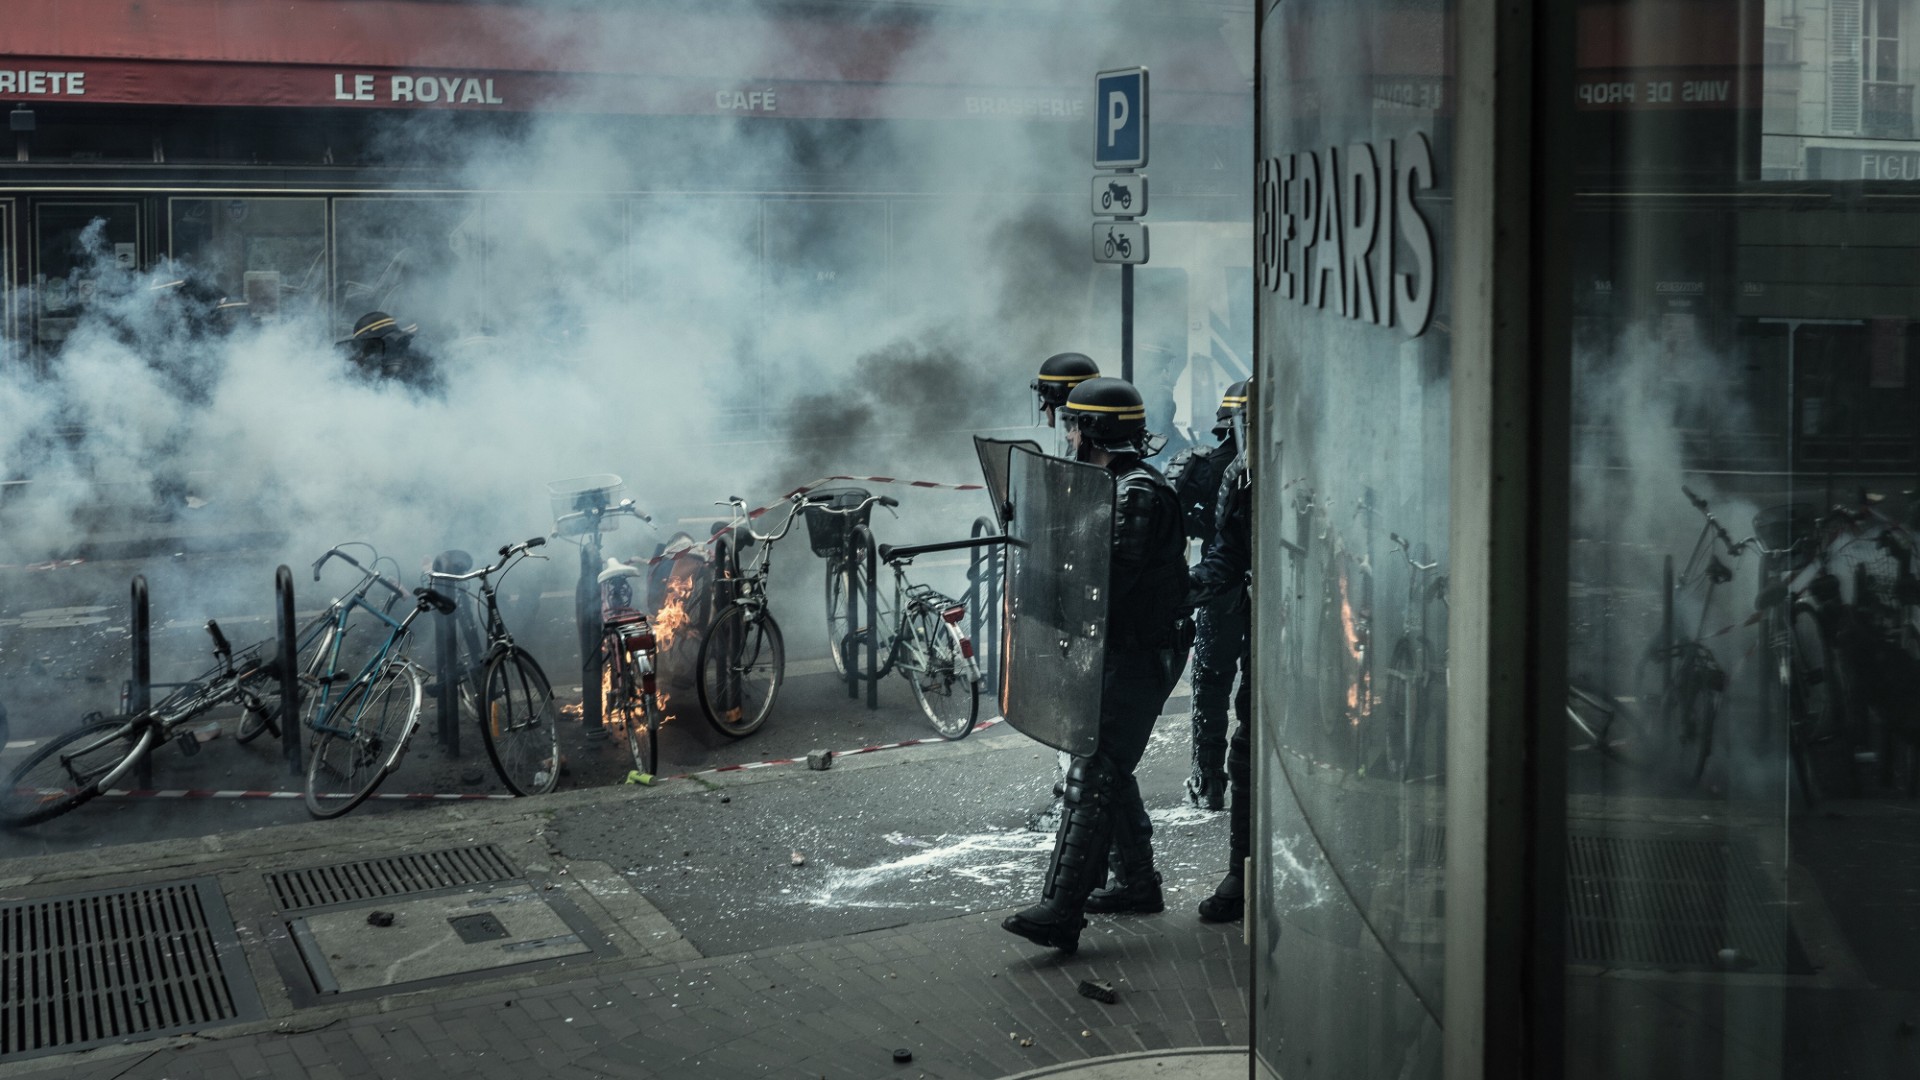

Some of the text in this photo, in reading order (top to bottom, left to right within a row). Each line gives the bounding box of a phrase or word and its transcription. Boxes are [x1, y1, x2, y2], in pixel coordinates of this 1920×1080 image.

[0, 70, 86, 95] RIETE
[334, 73, 503, 105] LE ROYAL
[715, 87, 777, 111] CAFÉ
[964, 96, 1085, 117] BRASSERIE
[1107, 90, 1130, 147] P
